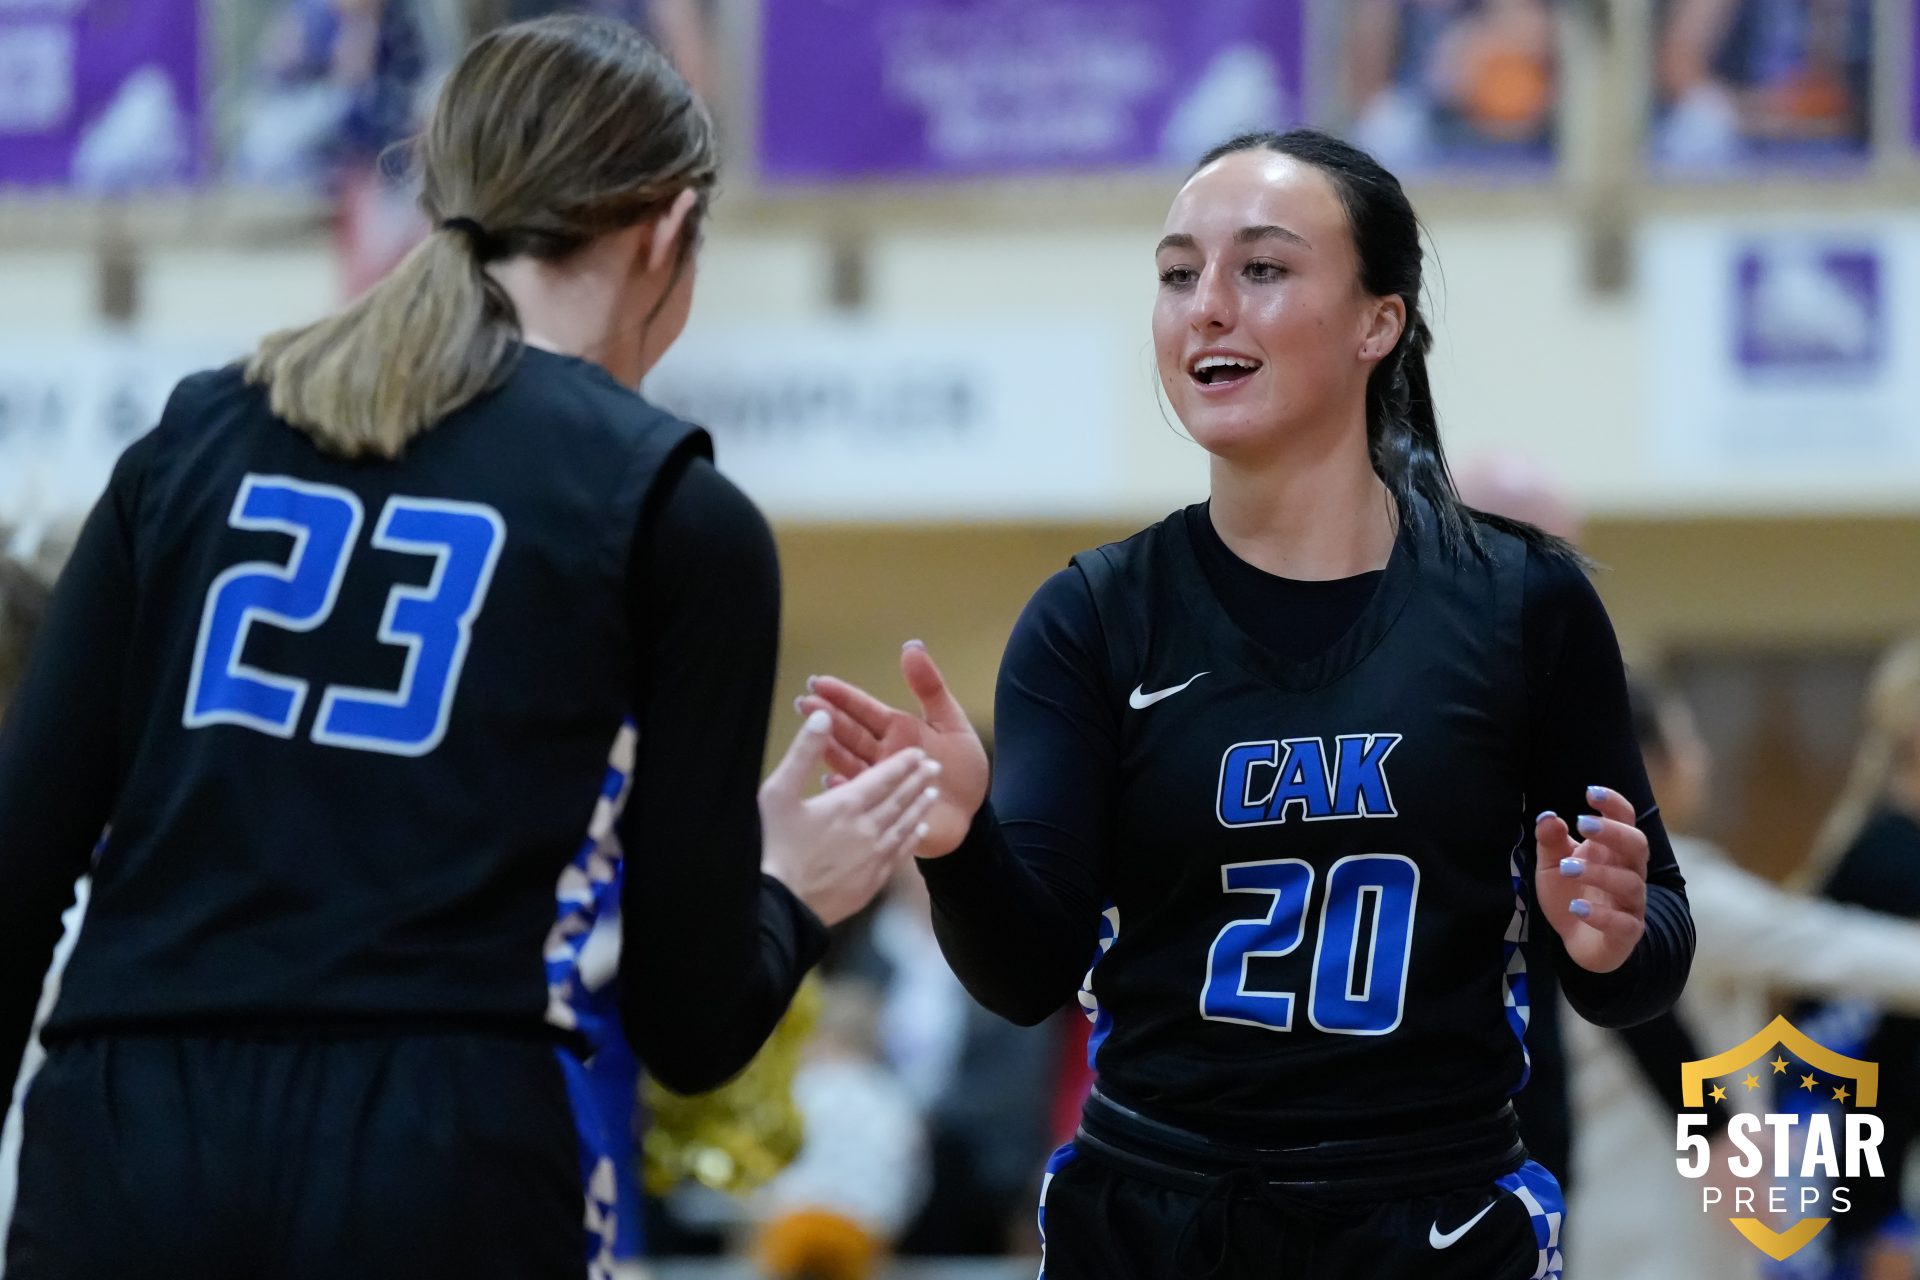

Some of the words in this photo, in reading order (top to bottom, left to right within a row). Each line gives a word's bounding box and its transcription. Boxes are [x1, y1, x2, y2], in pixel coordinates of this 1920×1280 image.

[182, 472, 507, 757] 23
[1216, 733, 1402, 829] CAK
[1200, 853, 1420, 1036] 20
